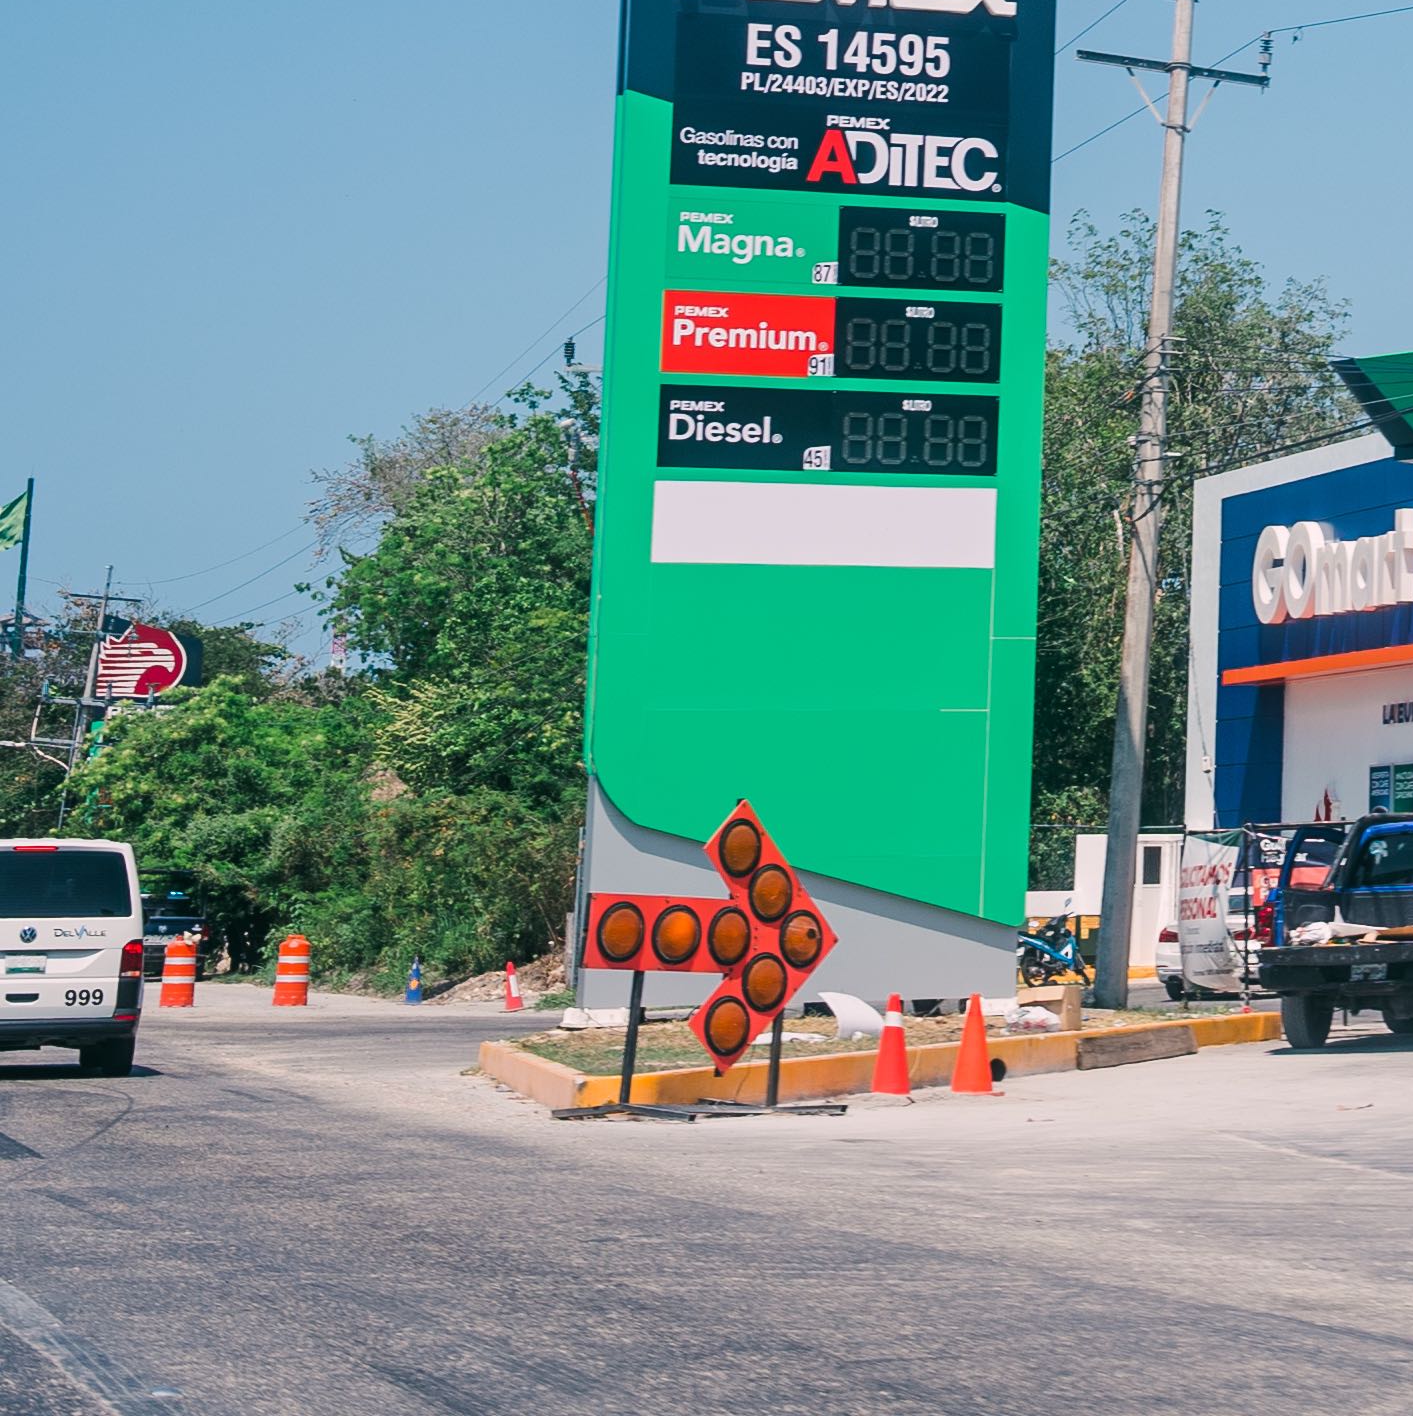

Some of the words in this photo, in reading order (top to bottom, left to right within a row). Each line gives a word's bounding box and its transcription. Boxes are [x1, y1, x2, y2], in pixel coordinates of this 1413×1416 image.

[745, 23, 802, 68] ES
[818, 28, 951, 78] 14595
[740, 71, 949, 103] PL/24403/EXP/ES/2022
[826, 115, 891, 130] PEMEX
[680, 127, 764, 149] Gasolinas
[768, 136, 799, 151] con
[697, 150, 798, 173] tecnología
[679, 211, 734, 224] PEMEX
[677, 225, 794, 265] Magna
[814, 264, 831, 282] 87
[674, 305, 729, 318] PEMEX
[672, 318, 817, 352] Premium
[808, 356, 827, 375] 91
[669, 399, 725, 412] PEMEX
[668, 413, 771, 444] Diesel
[804, 450, 822, 469] 45
[1382, 703, 1397, 724] LA
[64, 988, 104, 1007] 999
